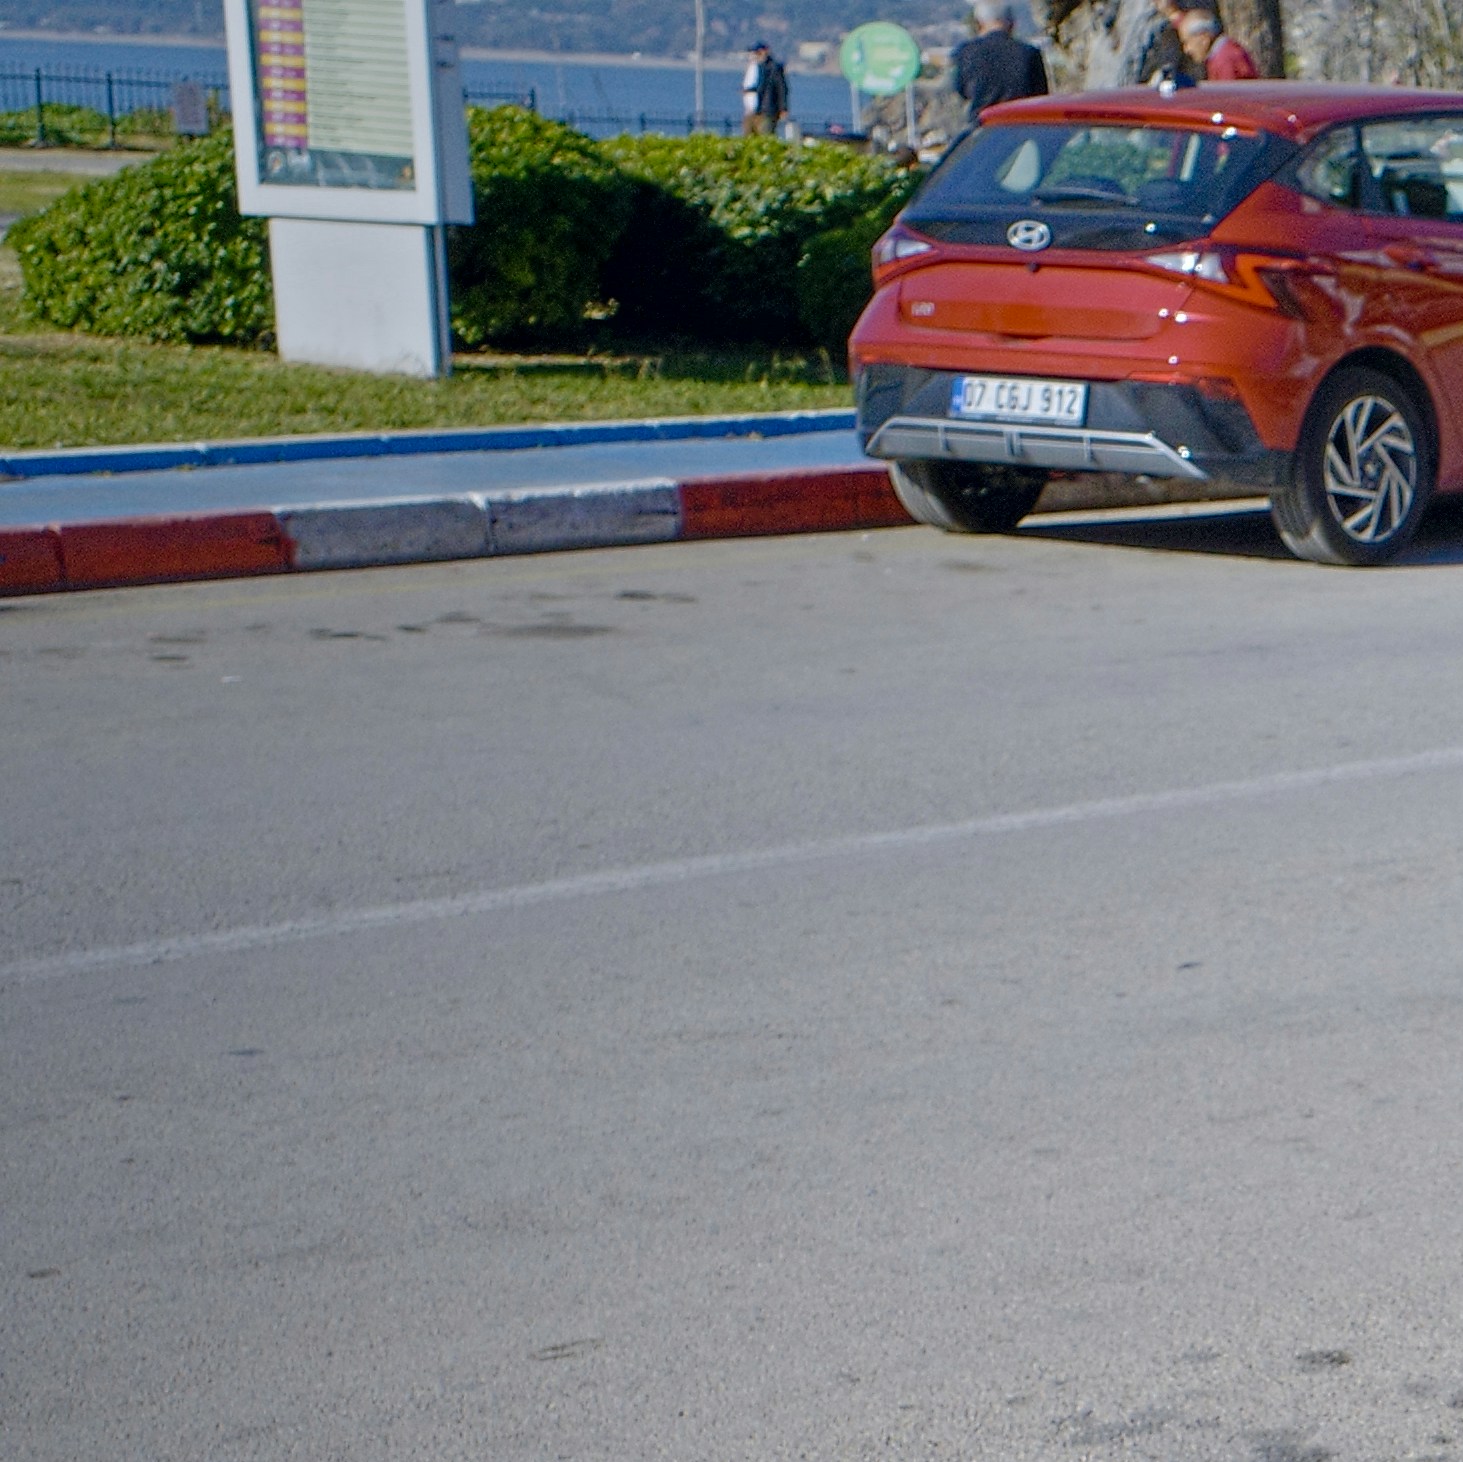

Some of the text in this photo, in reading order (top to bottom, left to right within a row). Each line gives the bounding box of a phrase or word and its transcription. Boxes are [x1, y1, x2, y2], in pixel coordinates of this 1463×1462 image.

[964, 381, 1078, 415] 07 CGJ 912
